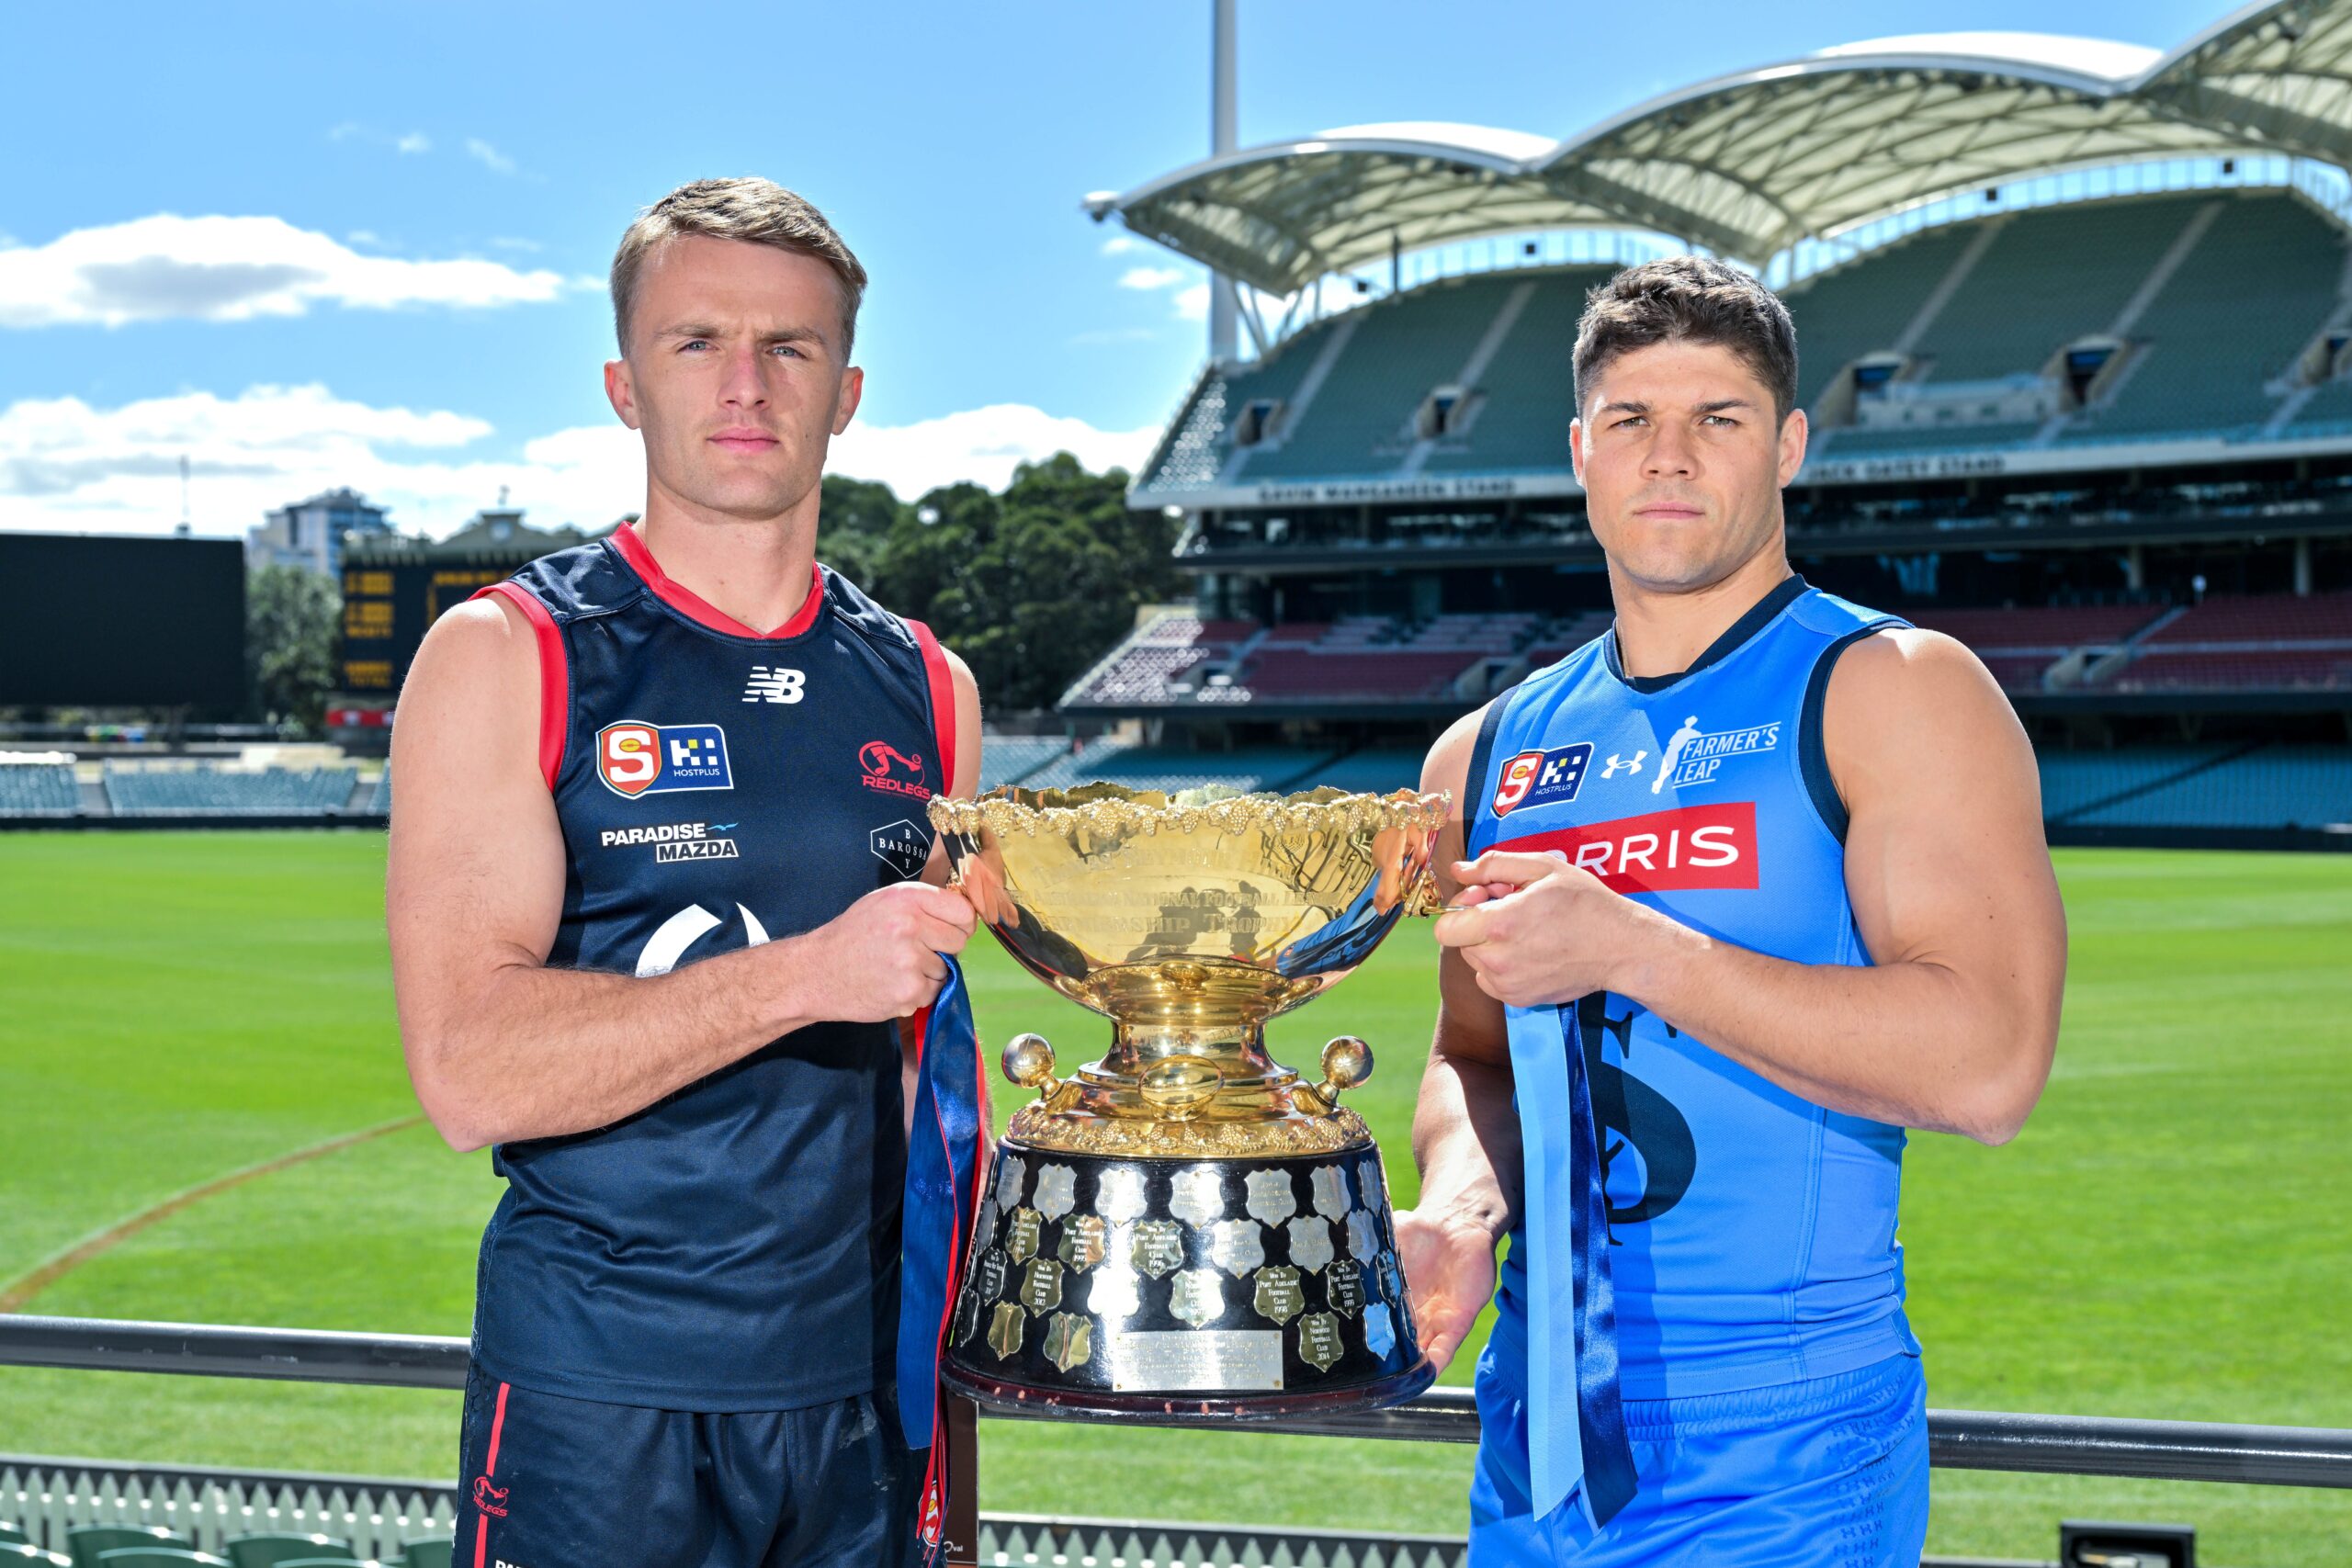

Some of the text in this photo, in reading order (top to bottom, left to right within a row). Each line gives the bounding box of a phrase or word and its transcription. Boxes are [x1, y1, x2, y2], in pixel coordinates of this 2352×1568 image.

[1939, 457, 2006, 475] STAND
[1682, 726, 1780, 761] FARMER'S
[673, 768, 720, 778] HOSTPLUS
[1674, 759, 1721, 784] LEAP
[862, 774, 931, 800] REDLEGS
[1535, 784, 1572, 796] HOSTPLUS
[601, 823, 707, 846] PARADISE
[658, 840, 736, 862] MAZDA
[879, 838, 927, 861] BAROSSA
[473, 1495, 508, 1517] REDLEGS
